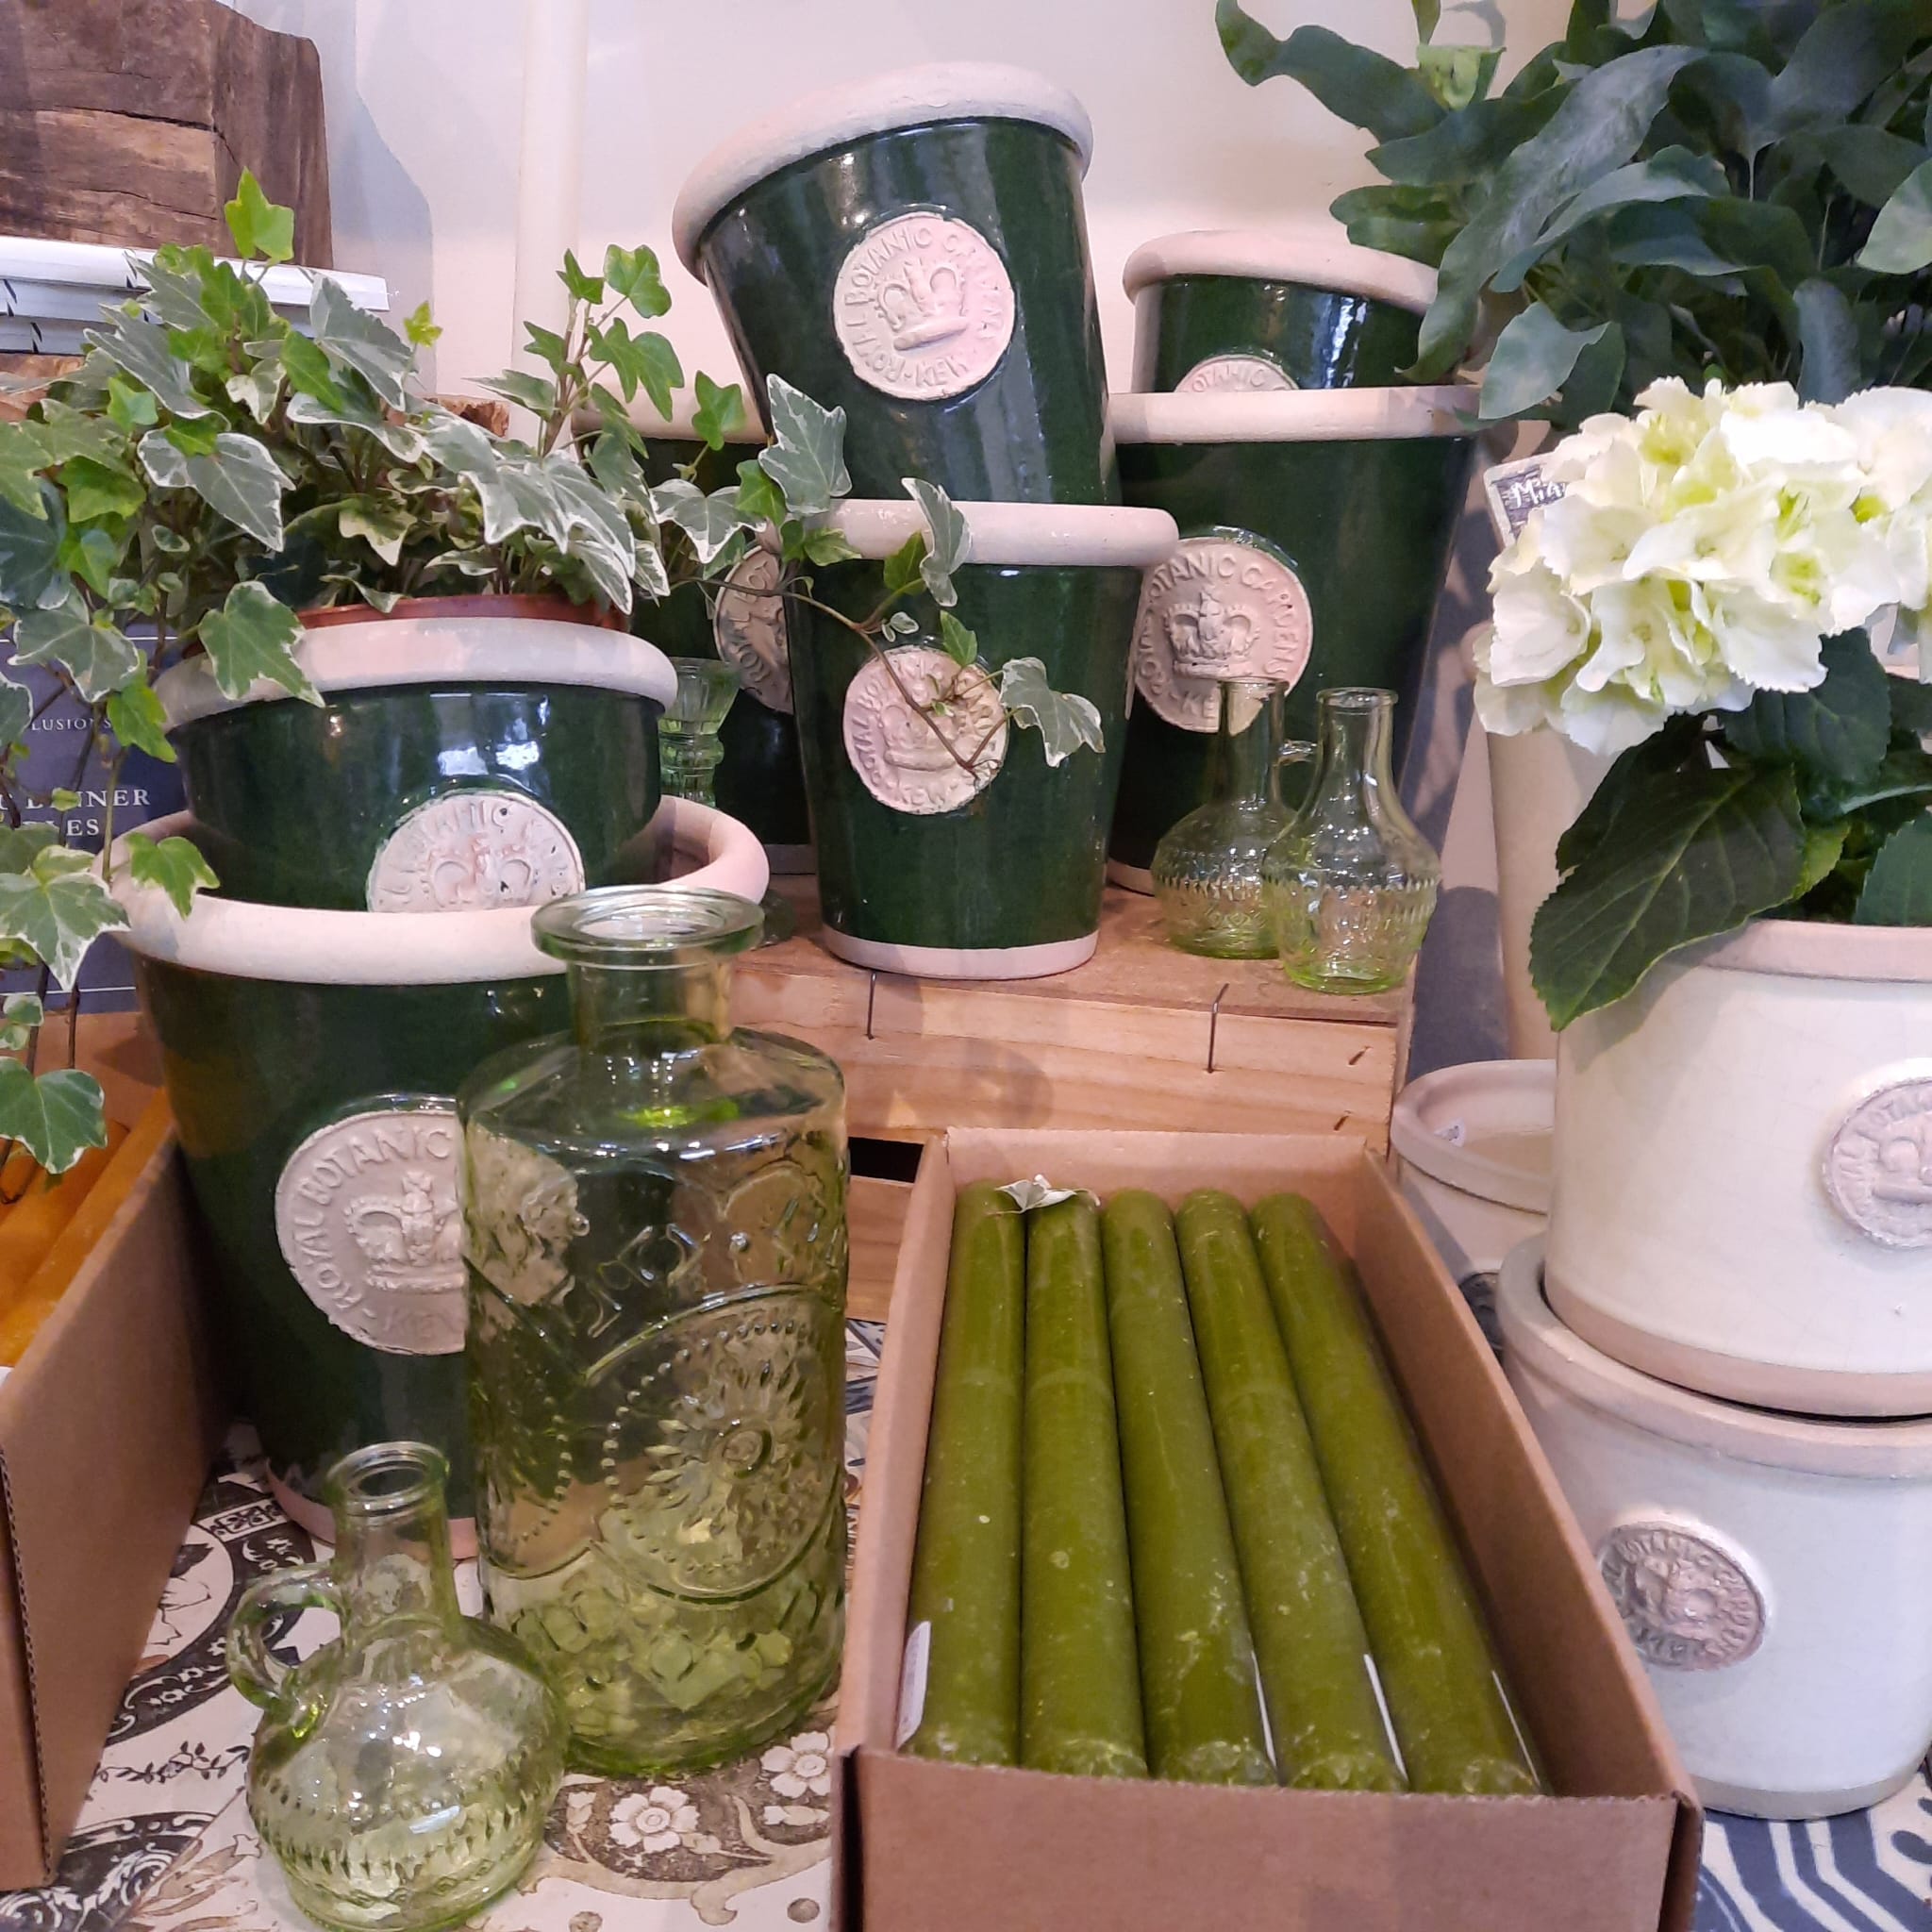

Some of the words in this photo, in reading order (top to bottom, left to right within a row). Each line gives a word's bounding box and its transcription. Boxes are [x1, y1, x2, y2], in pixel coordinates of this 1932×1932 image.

[31, 717, 112, 731] LUSIOS
[298, 1129, 454, 1206] BOTANIC
[291, 1209, 363, 1310] ROYAL
